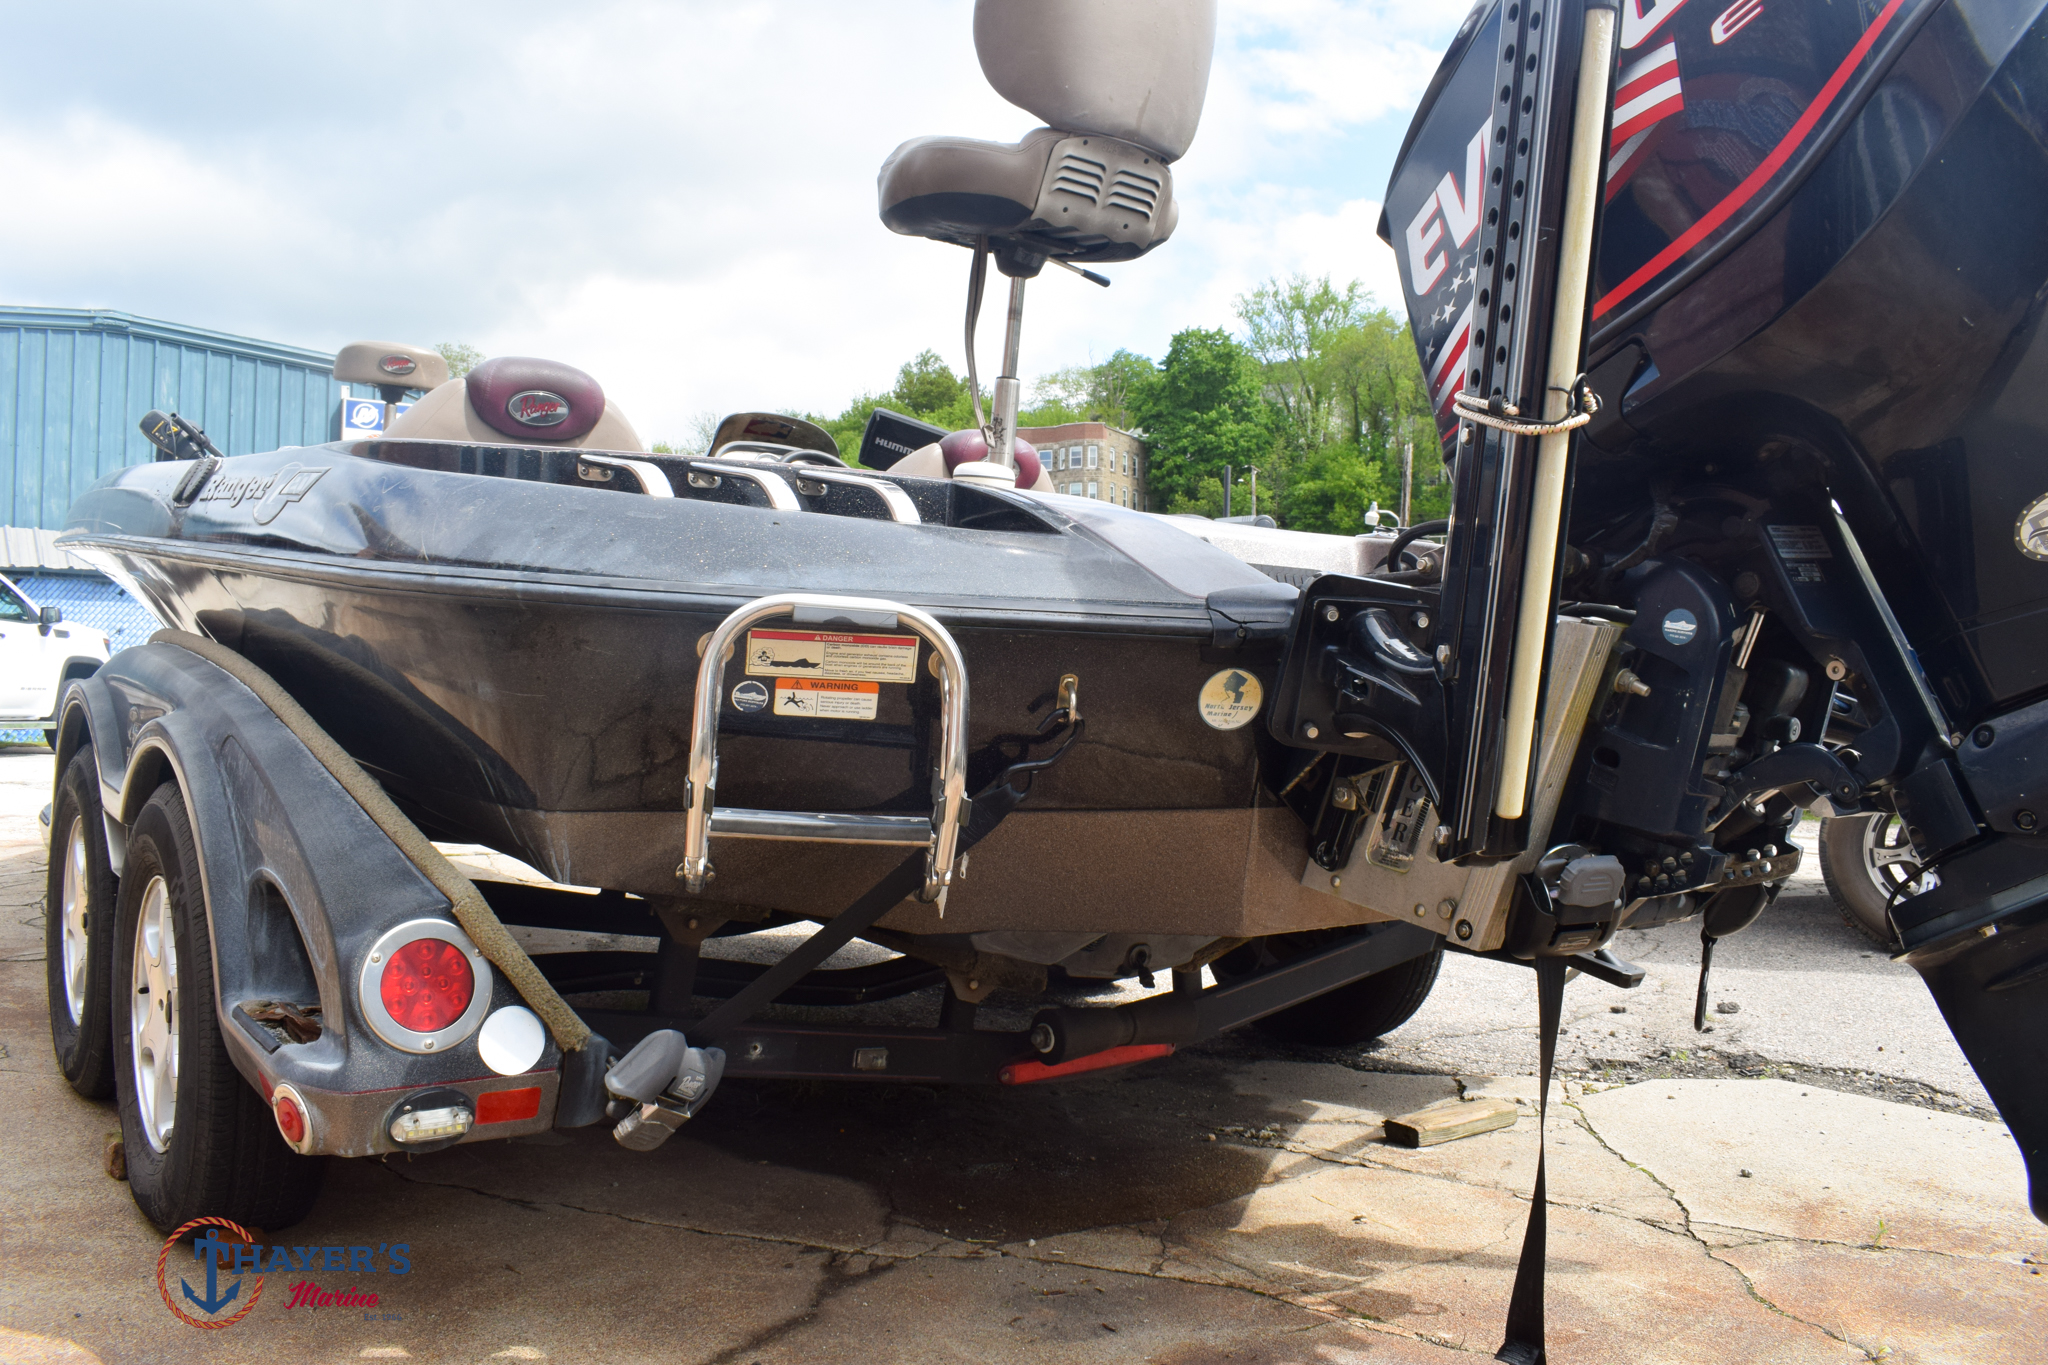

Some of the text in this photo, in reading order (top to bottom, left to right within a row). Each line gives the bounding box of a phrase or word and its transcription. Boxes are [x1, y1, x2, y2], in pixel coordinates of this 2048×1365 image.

[520, 395, 561, 418] Ranger
[874, 436, 914, 455] HUMM
[810, 682, 858, 691] WARNING
